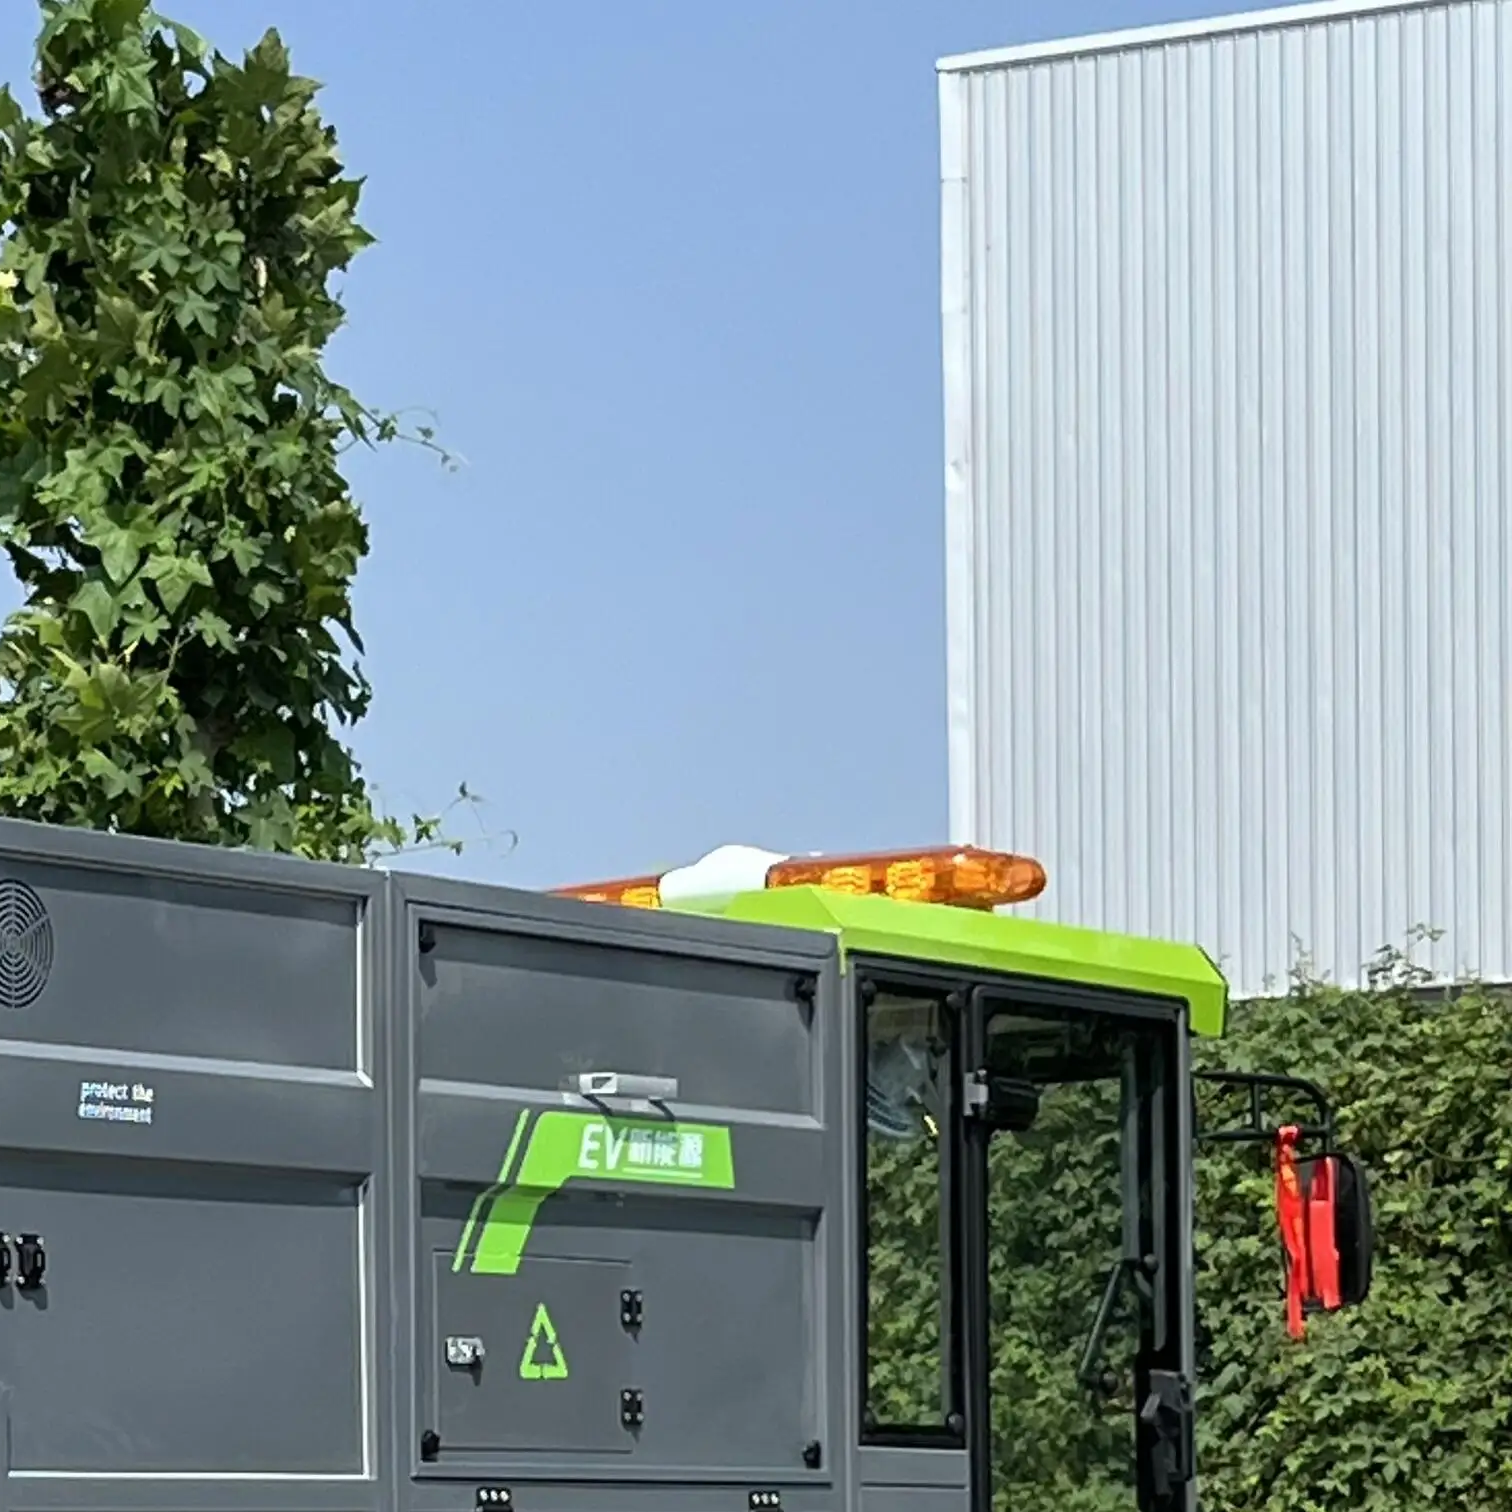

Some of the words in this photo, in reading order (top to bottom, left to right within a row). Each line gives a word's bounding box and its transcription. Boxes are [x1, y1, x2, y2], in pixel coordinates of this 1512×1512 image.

[80, 1082, 128, 1102] protect
[132, 1083, 154, 1102] the
[78, 1101, 152, 1125] environment
[578, 1123, 628, 1170] EV
